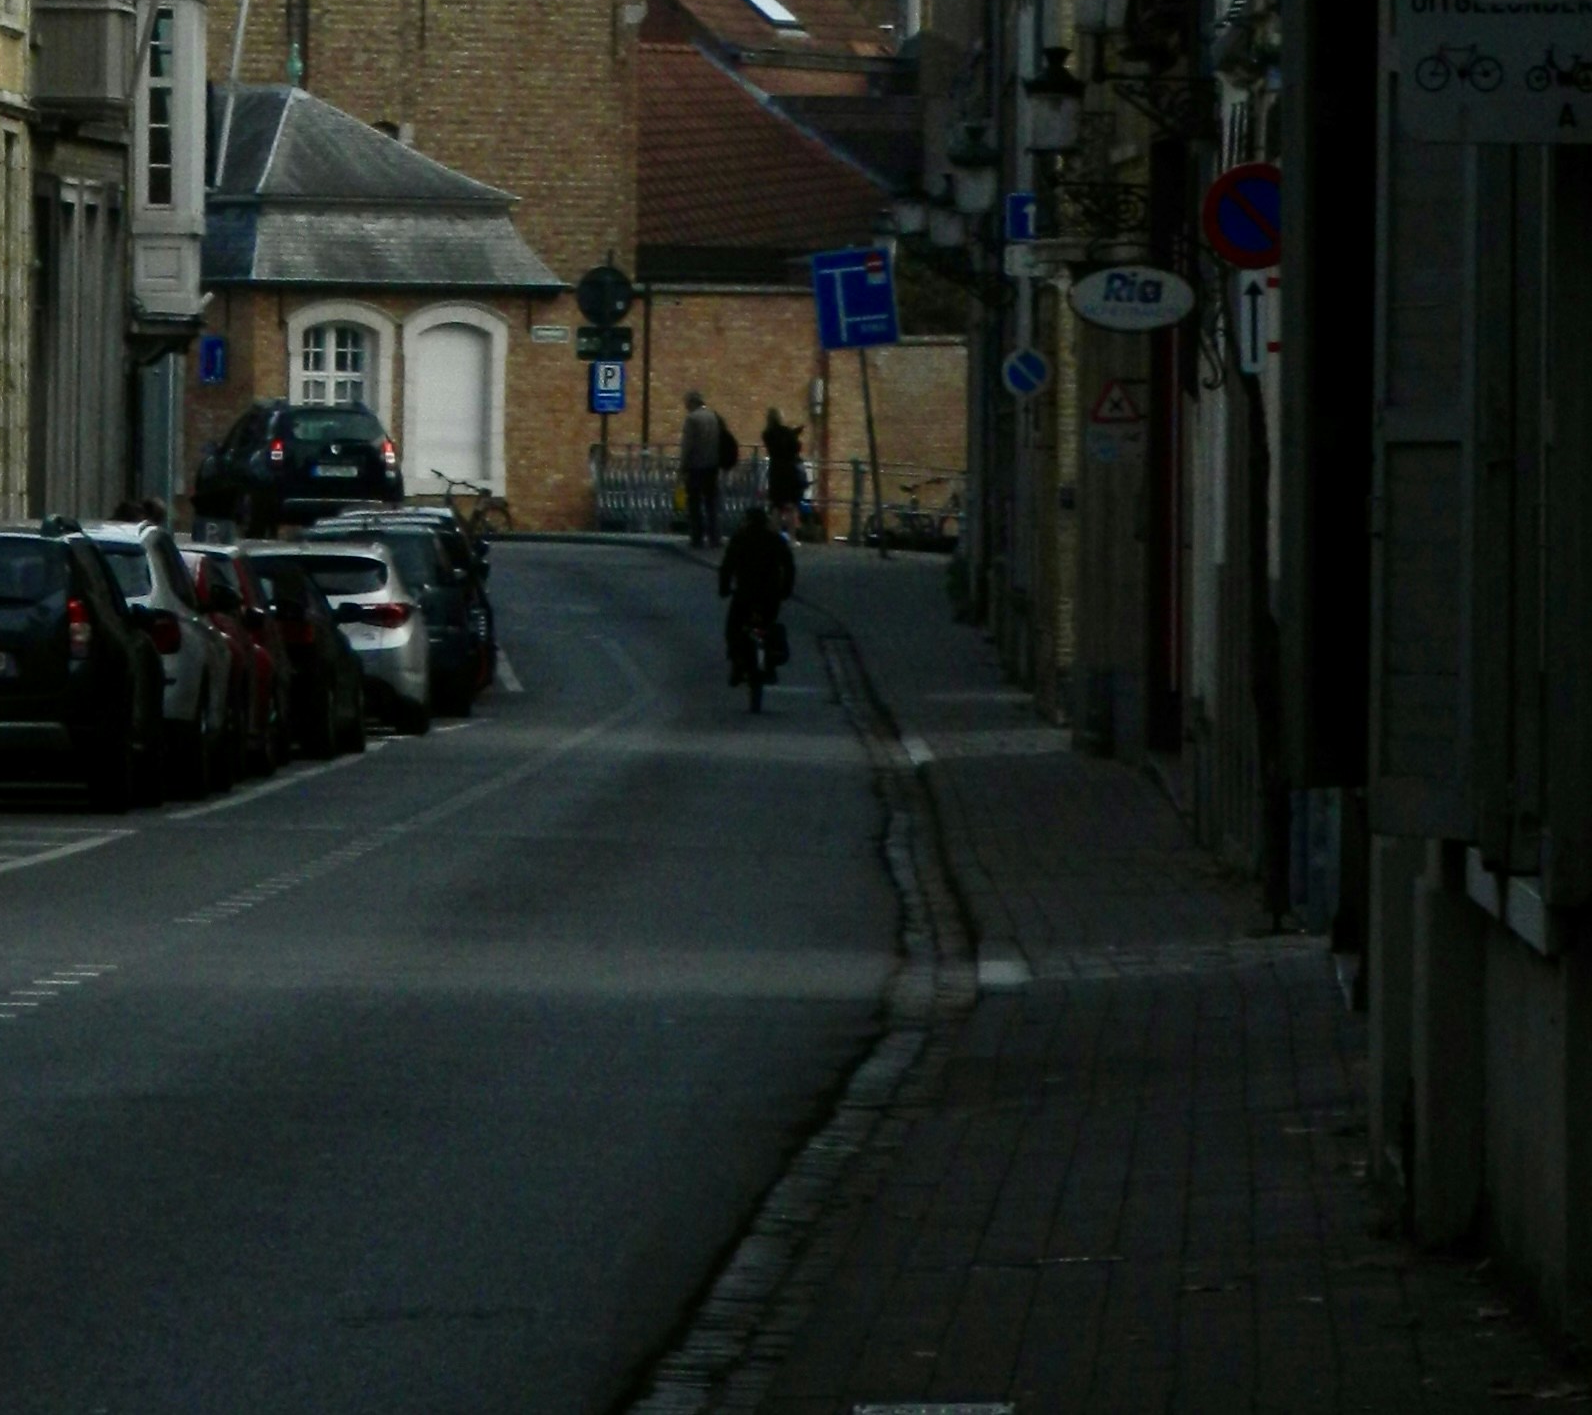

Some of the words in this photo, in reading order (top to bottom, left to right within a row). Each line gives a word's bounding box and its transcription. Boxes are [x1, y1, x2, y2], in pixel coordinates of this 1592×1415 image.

[1558, 102, 1577, 128] A
[1102, 271, 1163, 304] Ria
[603, 367, 615, 388] P
